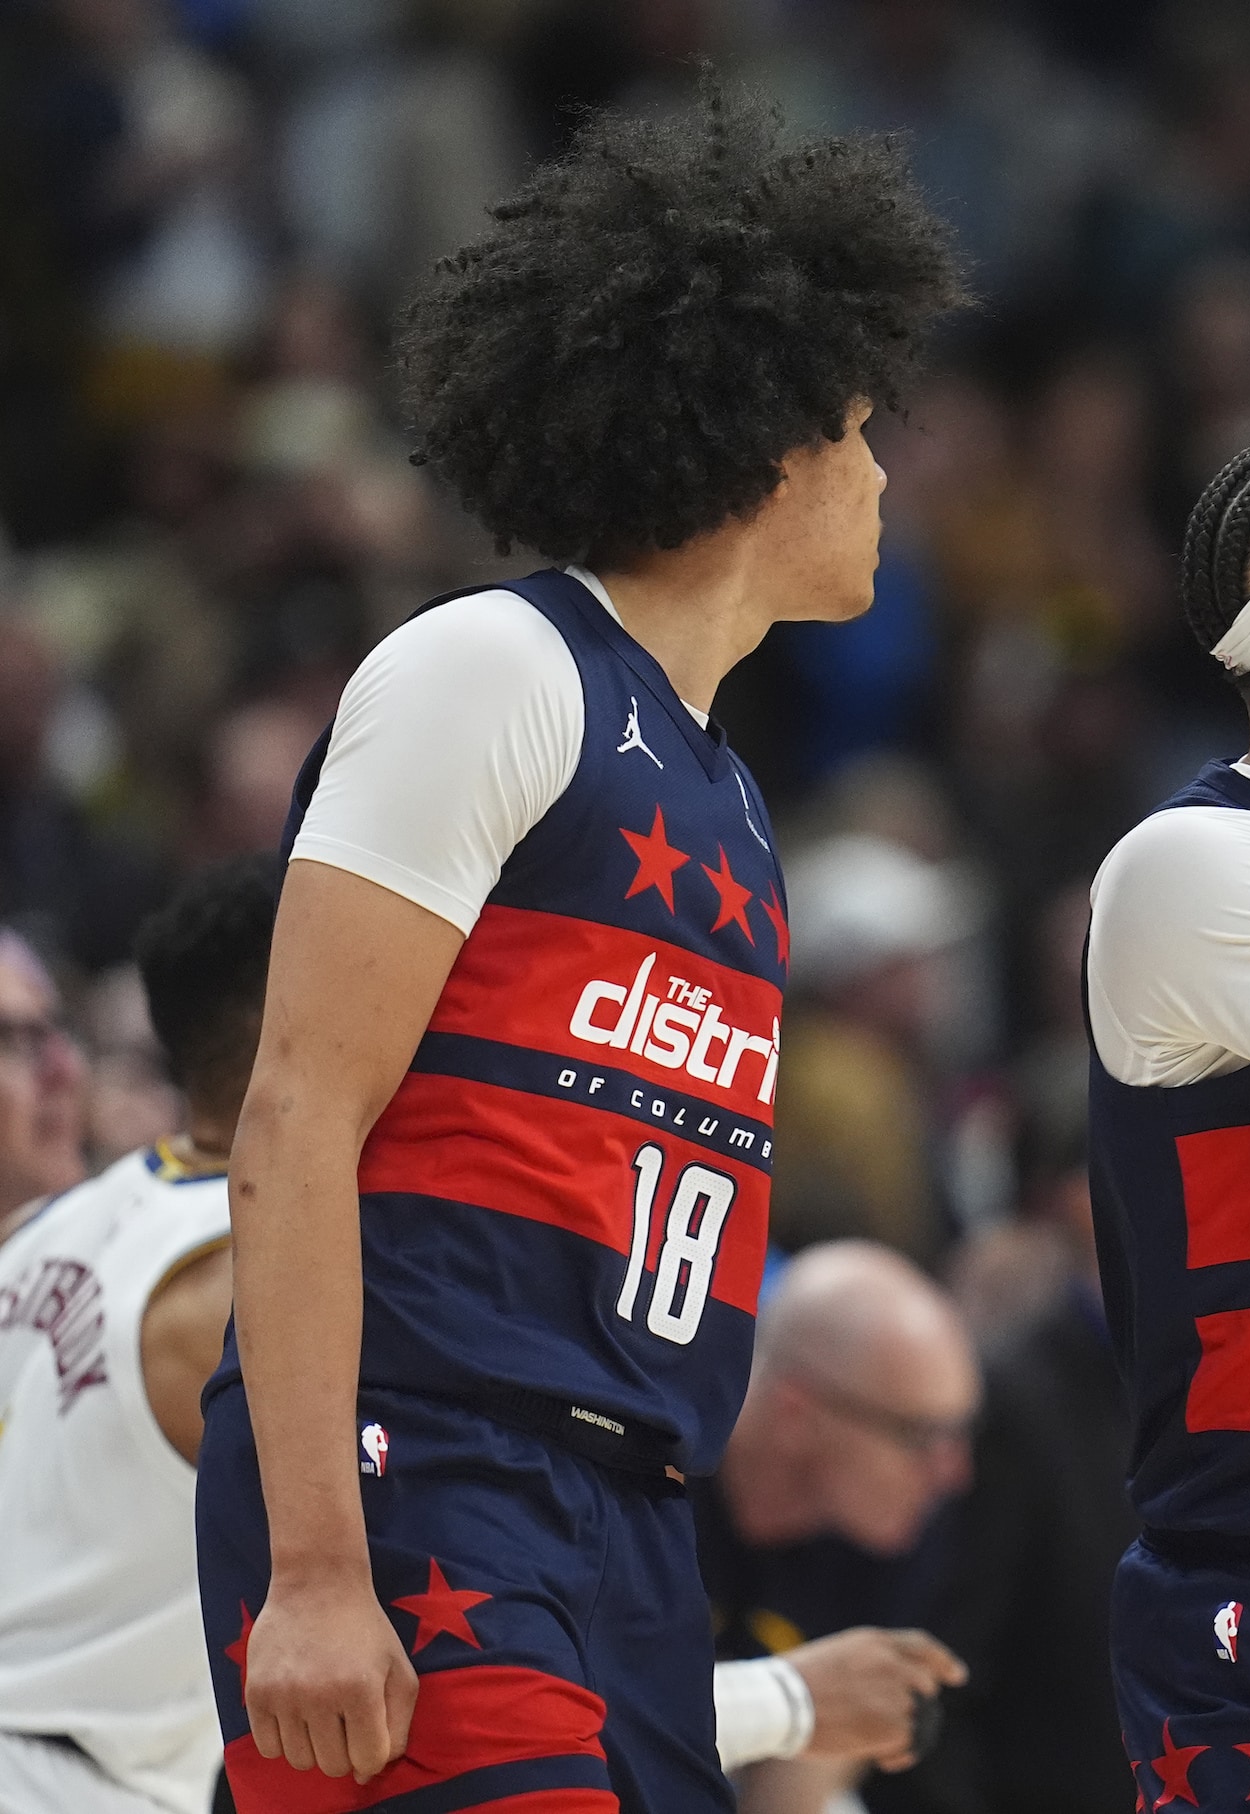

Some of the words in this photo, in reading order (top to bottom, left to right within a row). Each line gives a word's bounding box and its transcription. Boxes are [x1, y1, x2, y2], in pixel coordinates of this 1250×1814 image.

[667, 976, 713, 1011] THE
[569, 951, 781, 1105] distri
[557, 1069, 605, 1094] OF
[631, 1090, 773, 1164] COLUMB
[615, 1142, 737, 1346] 18
[571, 1406, 625, 1436] WASHINGTON
[361, 1461, 375, 1474] NBA
